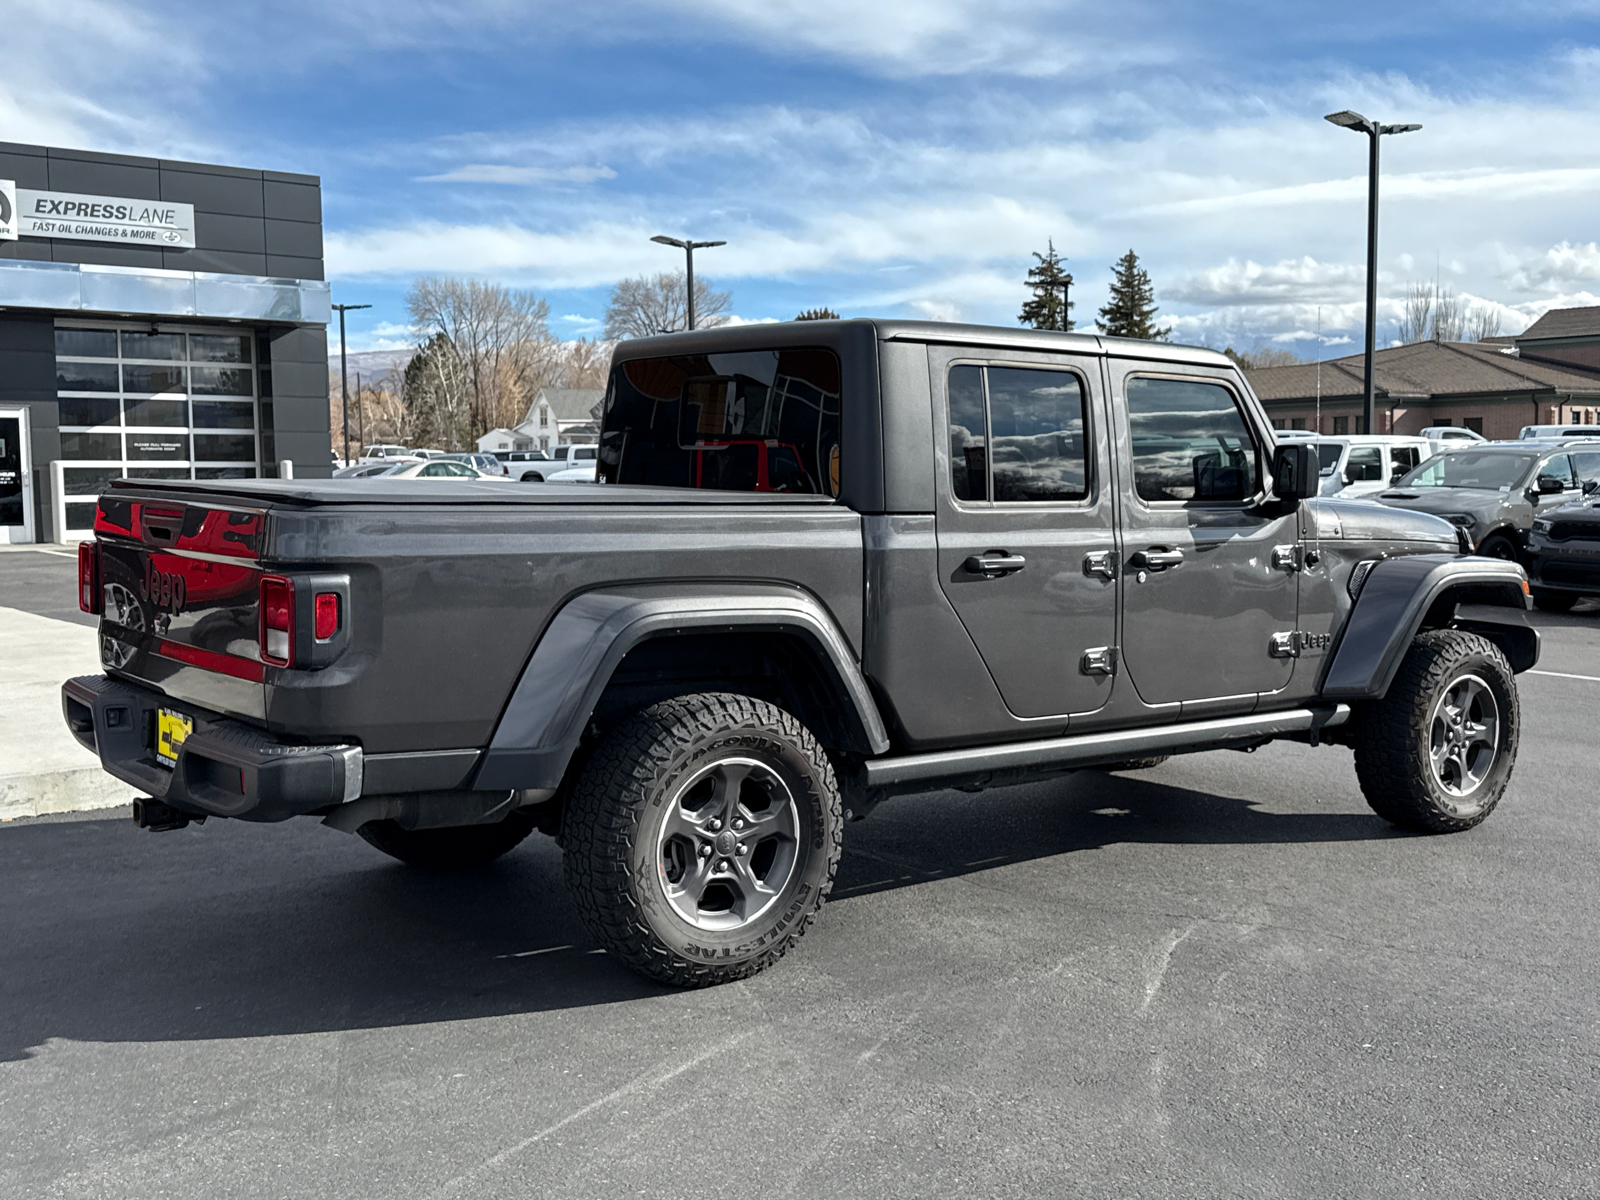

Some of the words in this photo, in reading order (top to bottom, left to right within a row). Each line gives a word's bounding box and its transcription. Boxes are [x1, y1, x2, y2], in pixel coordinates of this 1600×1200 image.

[32, 221, 57, 233] FAST
[58, 223, 73, 235] OIL
[75, 225, 119, 238] CHANGES
[120, 229, 128, 238] &
[130, 229, 157, 241] MORE
[139, 557, 187, 617] Jeep
[1300, 631, 1331, 651] Jeep
[652, 734, 783, 808] PATAGONIA
[684, 897, 805, 959] MILESTAR
